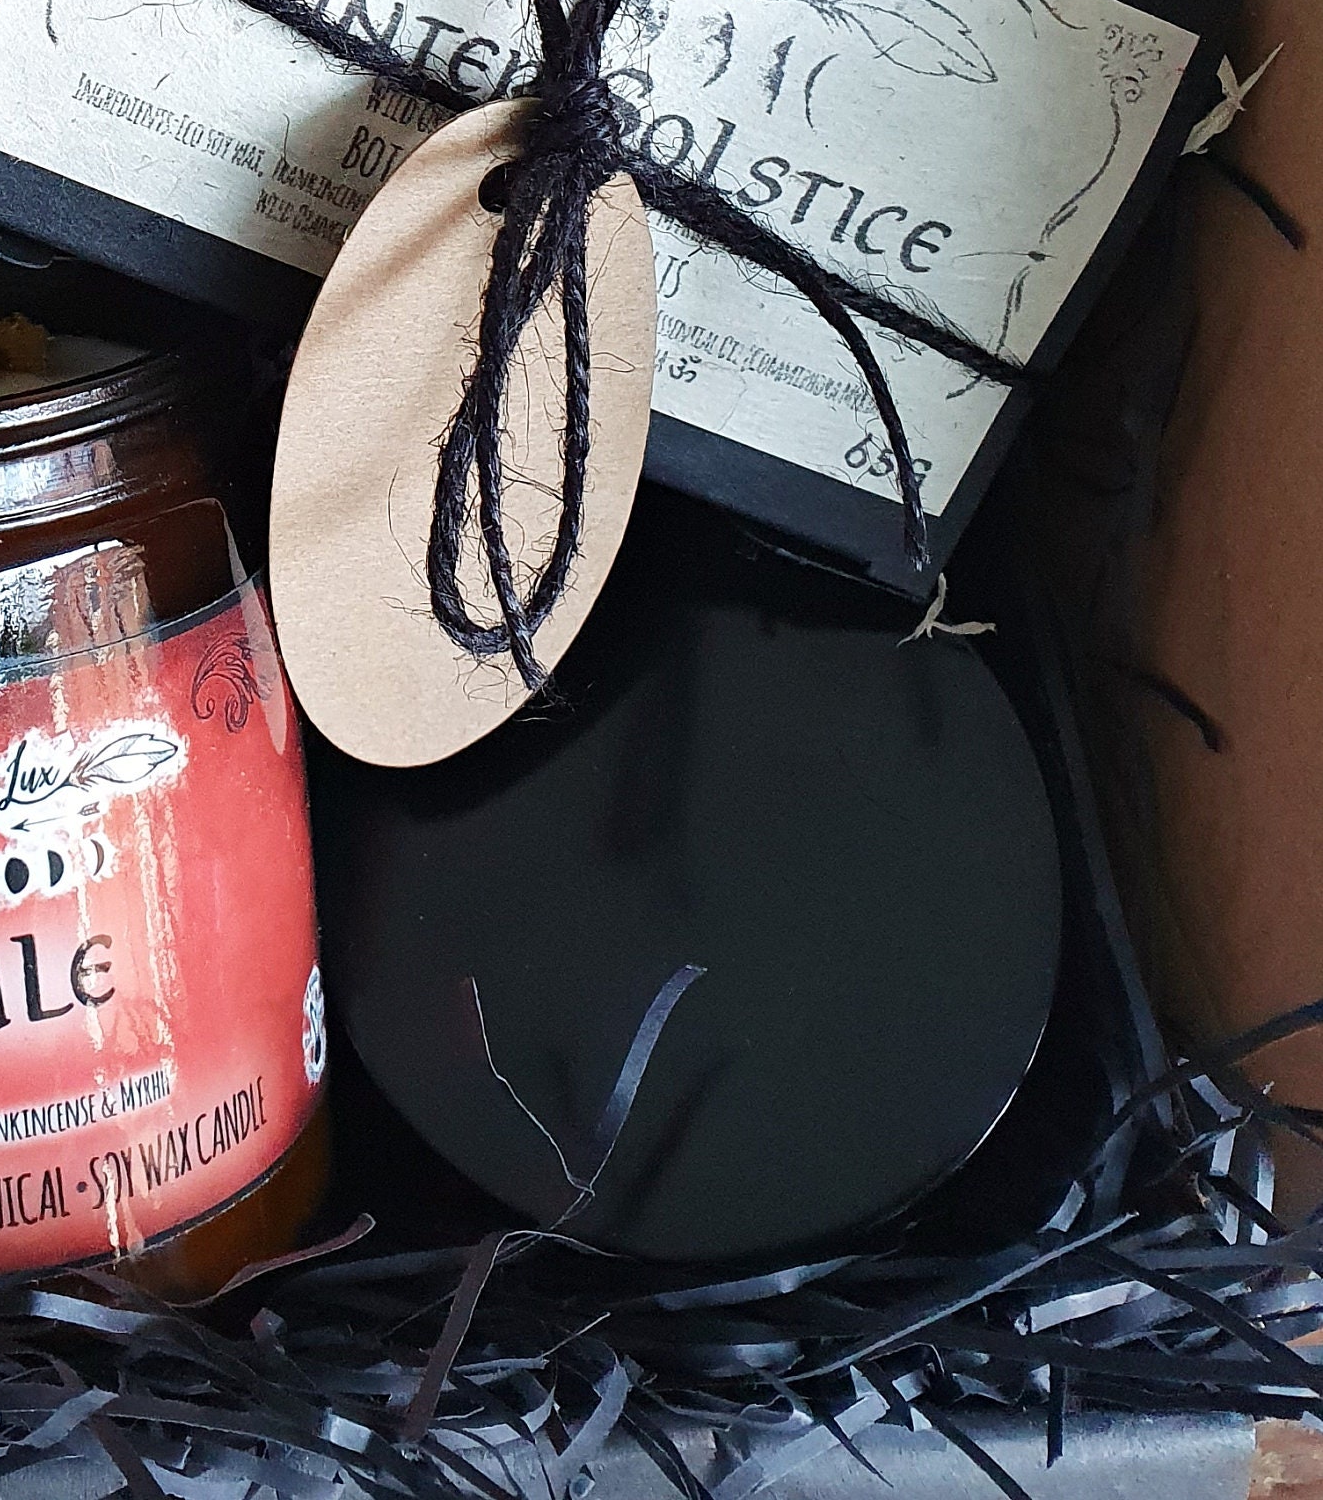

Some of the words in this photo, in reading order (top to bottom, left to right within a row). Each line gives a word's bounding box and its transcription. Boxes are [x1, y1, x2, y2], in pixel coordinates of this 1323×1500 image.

[341, 125, 404, 182] BOT
[100, 1087, 118, 1119] &
[88, 1150, 134, 1211] SOY
[139, 1121, 193, 1187] WAX
[196, 1075, 269, 1165] CANDLE
